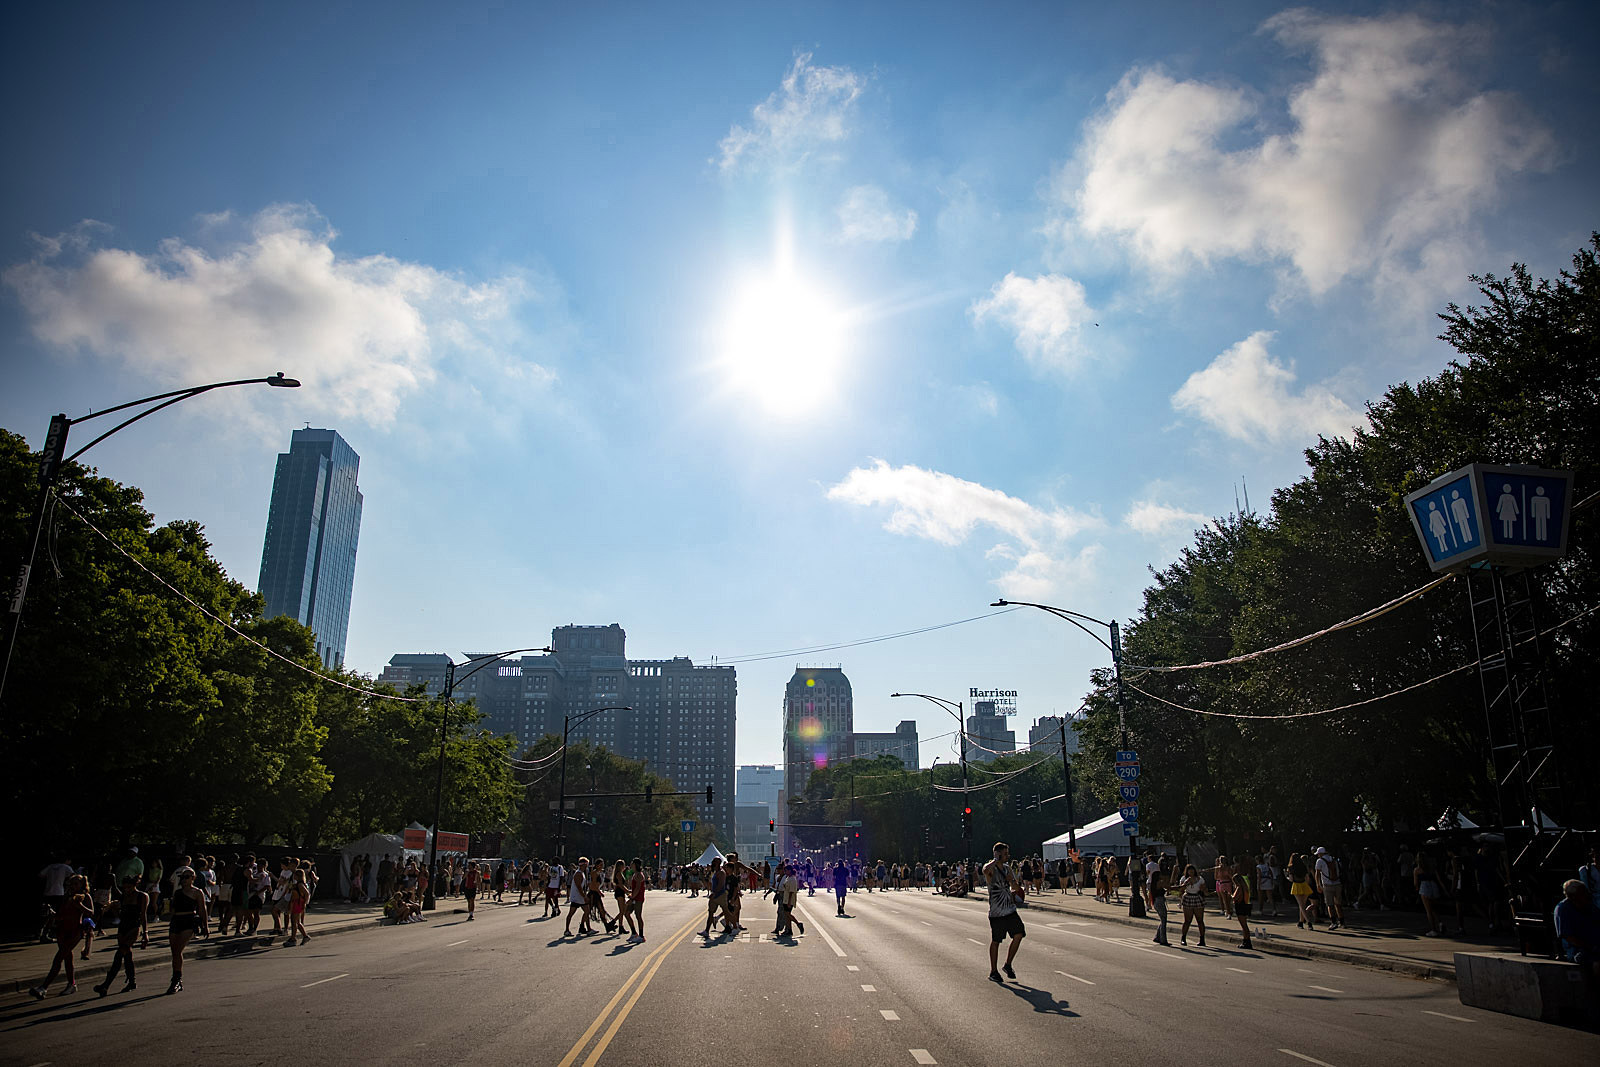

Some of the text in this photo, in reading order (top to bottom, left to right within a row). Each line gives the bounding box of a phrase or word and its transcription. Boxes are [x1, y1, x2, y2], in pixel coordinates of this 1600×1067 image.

[41, 422, 61, 476] B321
[1112, 626, 1120, 657] B310
[969, 688, 1018, 697] Harrison
[1120, 767, 1136, 777] 290
[1123, 787, 1136, 797] 90
[1122, 808, 1136, 818] 94
